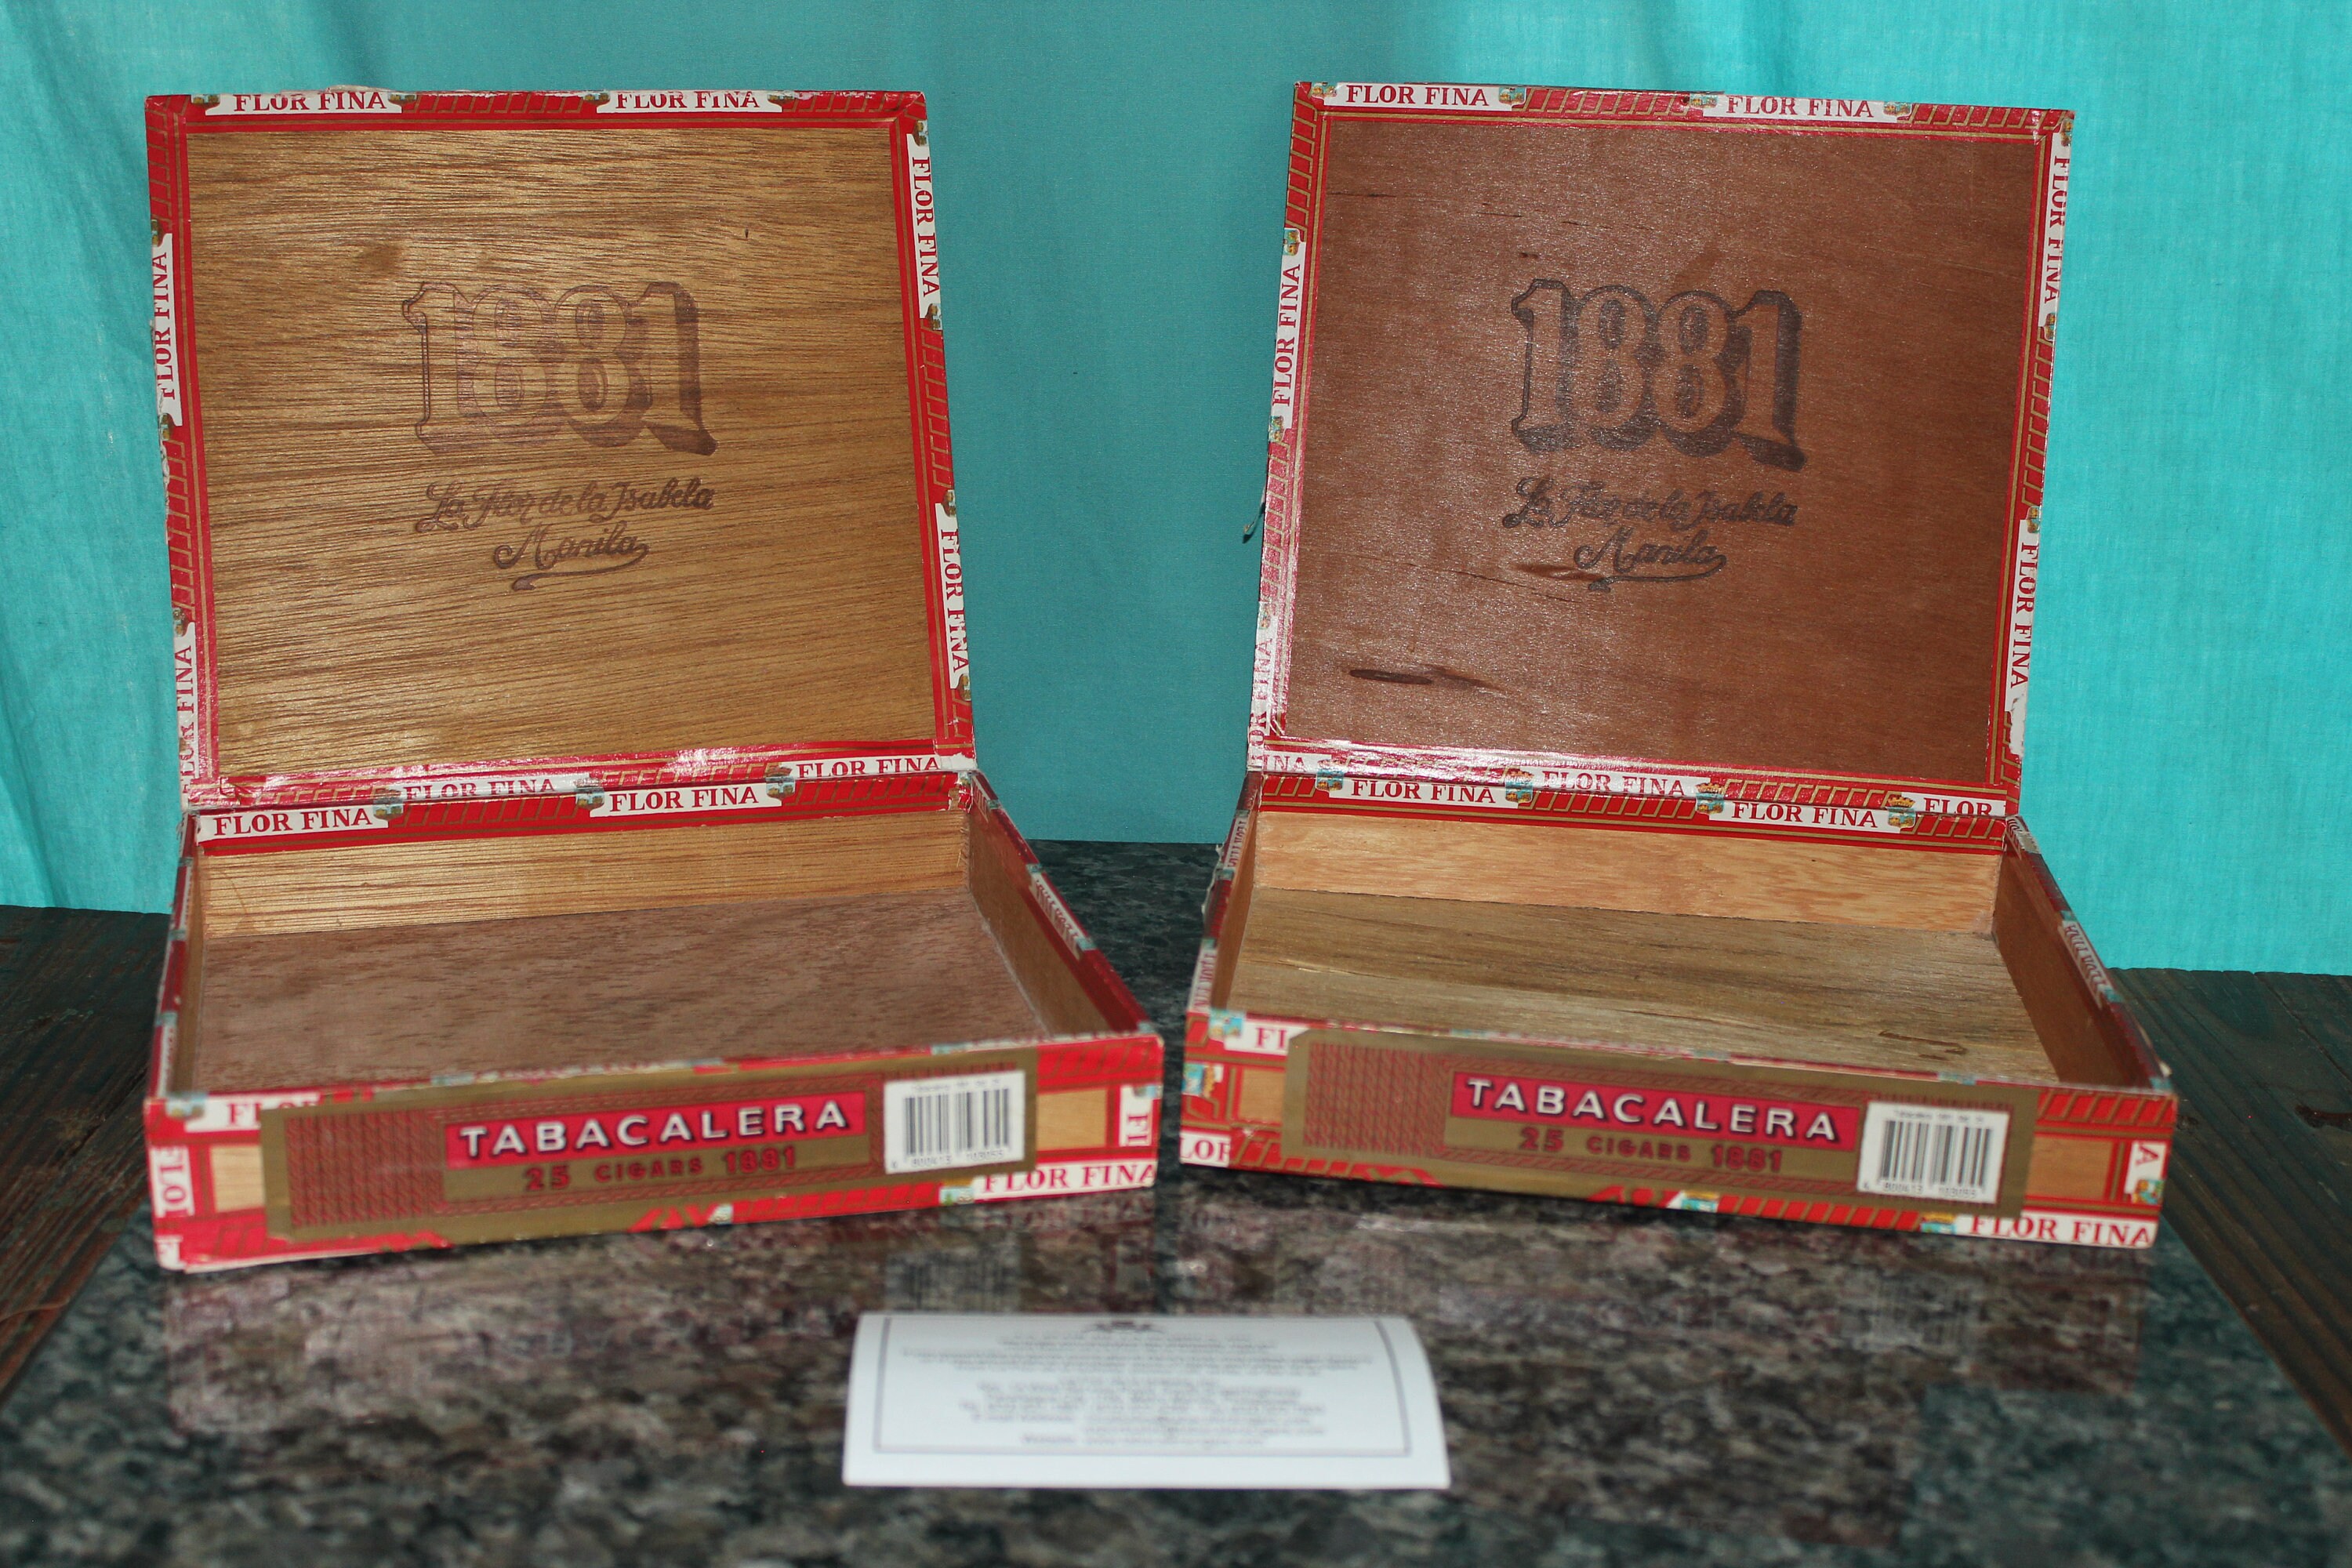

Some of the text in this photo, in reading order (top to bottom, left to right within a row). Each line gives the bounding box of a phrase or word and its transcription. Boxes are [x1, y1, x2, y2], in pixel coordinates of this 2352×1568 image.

[233, 91, 389, 112] FLOR FINA
[615, 89, 760, 110] FLOR FINA
[1345, 84, 1490, 107] FLOR FINA
[1725, 95, 1875, 119] FLOR FINA
[912, 156, 941, 298] FLOR FINA
[2044, 155, 2071, 305] FLOR FINA
[152, 251, 176, 401] FLOR FINA
[1272, 263, 1301, 408] FLOR FINA
[402, 281, 720, 457] 1881
[1511, 278, 1809, 472] 1881
[416, 479, 466, 534] La
[538, 485, 573, 517] de
[575, 480, 609, 515] la
[588, 476, 716, 524] Isabela
[1501, 476, 1552, 529] La
[1657, 488, 1692, 523] la
[493, 519, 651, 592] Manila
[1573, 525, 1728, 593] Manila
[941, 529, 970, 674] FLOR FINA
[2009, 542, 2039, 689] FLOR FINA
[174, 645, 194, 714] FINA
[1251, 637, 1273, 701] FINA
[406, 778, 557, 802] FLOR FINA
[796, 756, 942, 779] FLOR FINA
[1351, 778, 1497, 805] FLOR FINA
[1542, 770, 1686, 797] FLOR FINA
[213, 806, 373, 837] FLOR FINA
[609, 786, 760, 813] FLOR FINA
[1731, 801, 1879, 829] FLOR FINA
[1923, 797, 1995, 815] FLOR
[459, 1099, 848, 1159] TABACALERA
[1466, 1077, 1838, 1143] TABACALERA
[524, 1145, 797, 1192] 25 CIGARS 1881
[1519, 1126, 1784, 1174] 25 CIGARS 1881
[983, 1163, 1156, 1193] FLOR FINA
[1969, 1215, 2152, 1247] FLOR FINA
